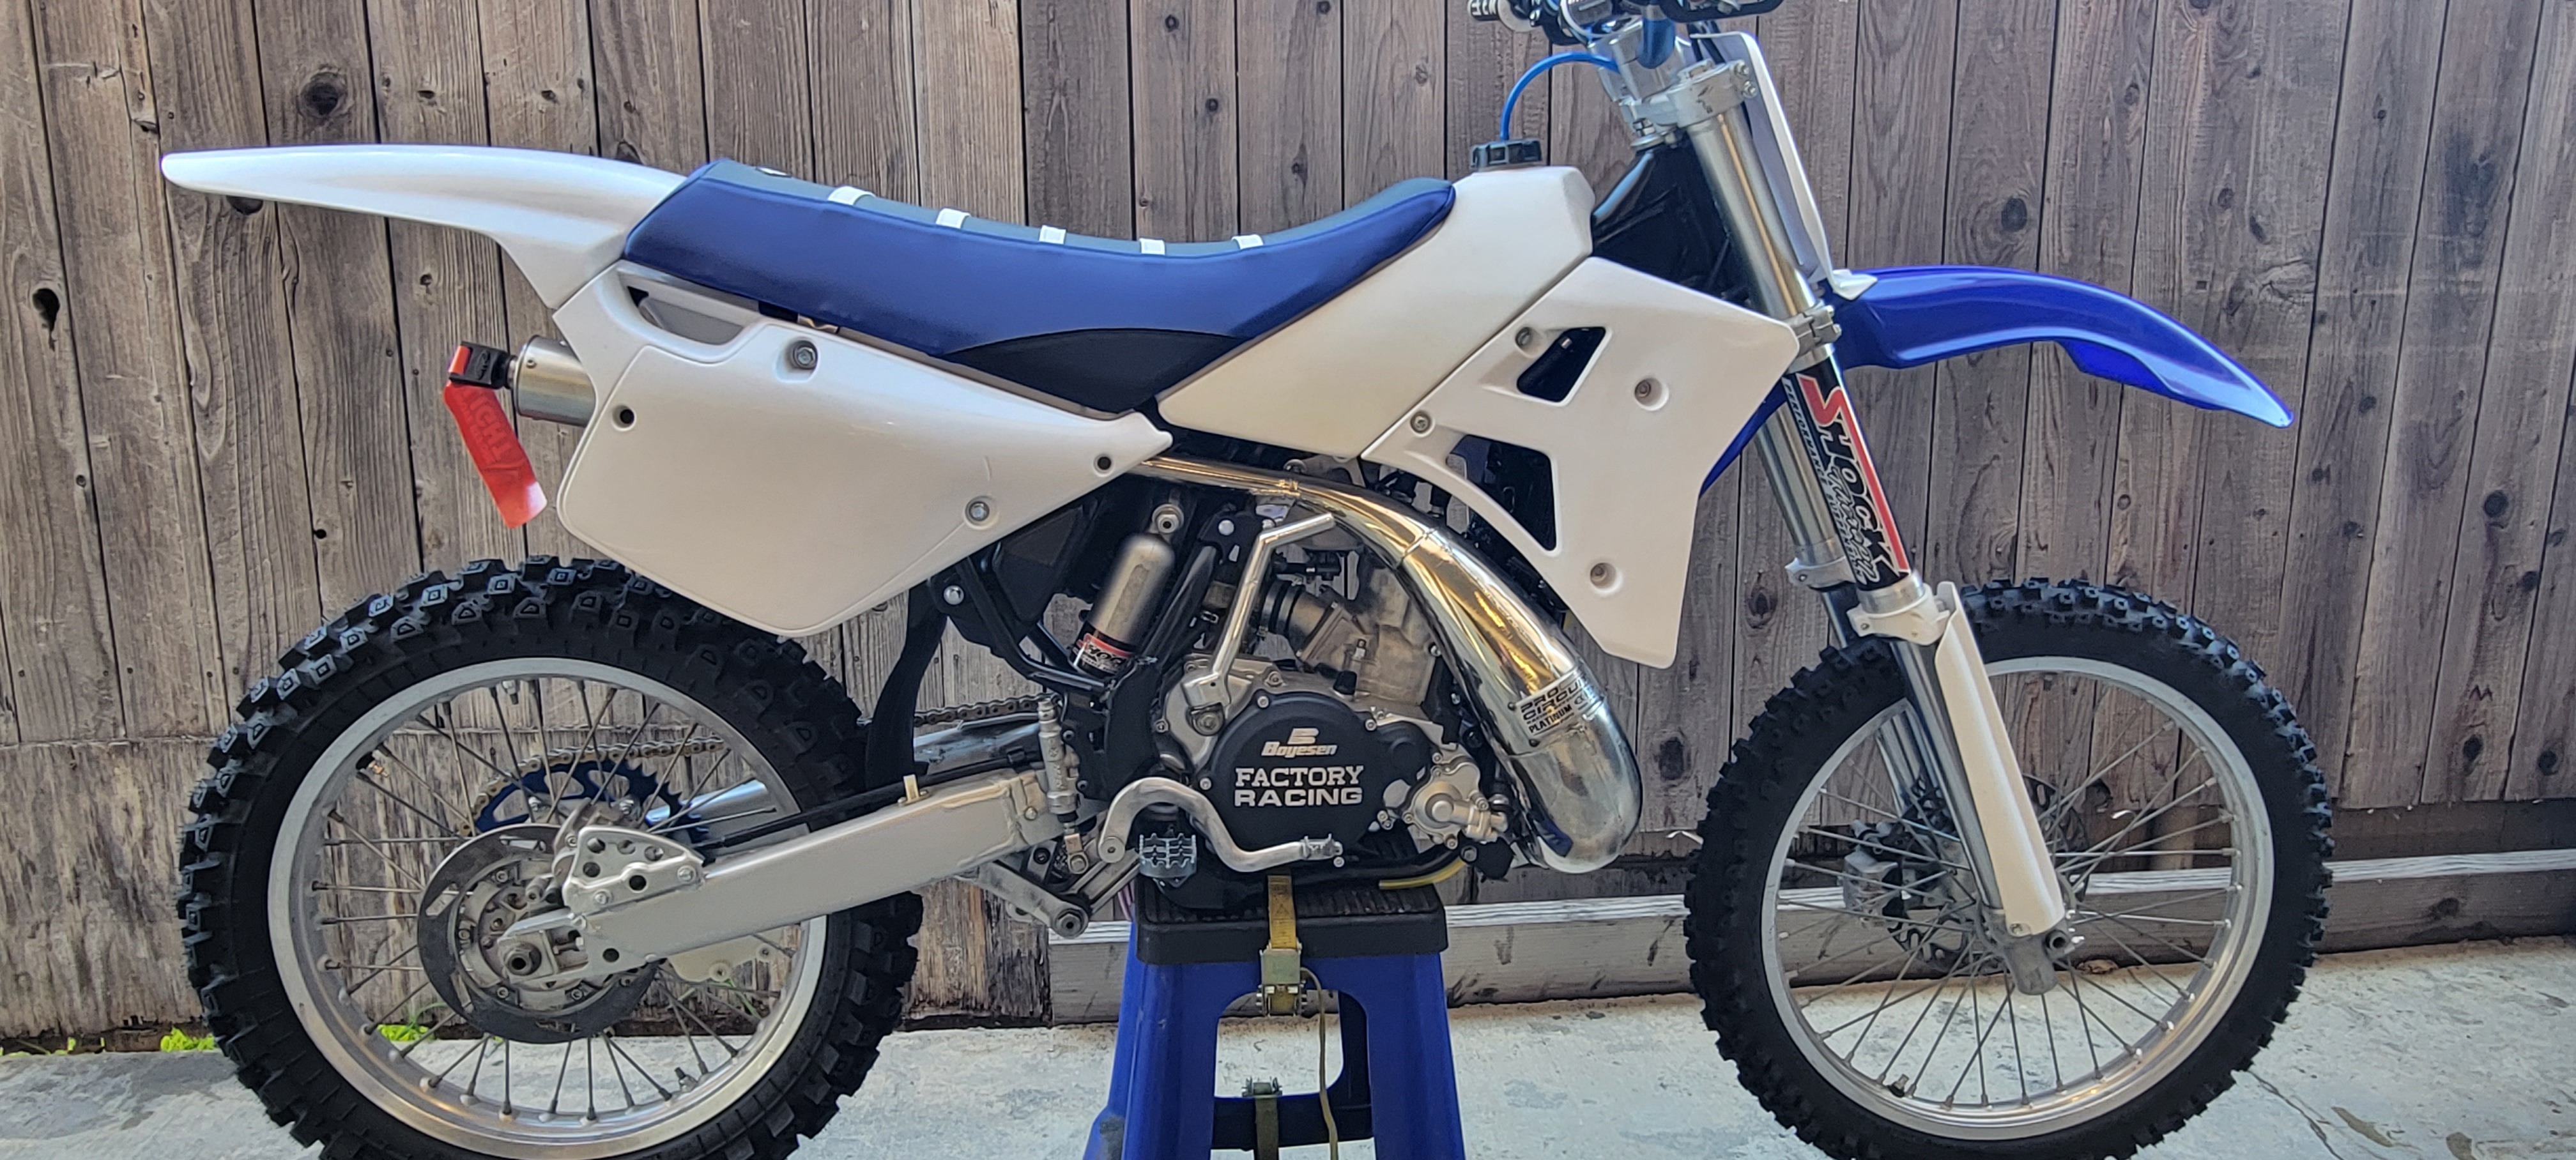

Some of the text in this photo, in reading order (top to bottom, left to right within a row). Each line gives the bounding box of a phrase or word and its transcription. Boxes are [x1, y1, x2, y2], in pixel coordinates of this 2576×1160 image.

[1784, 383, 1828, 484] PERFORMANCE
[1796, 373, 1911, 577] SHOCK
[1520, 687, 1559, 714] PRO
[1528, 703, 1573, 733] PLATINUM
[1261, 741, 1338, 758] Boyesen
[1235, 765, 1365, 787] FACTORY
[1234, 787, 1363, 807] RACING
